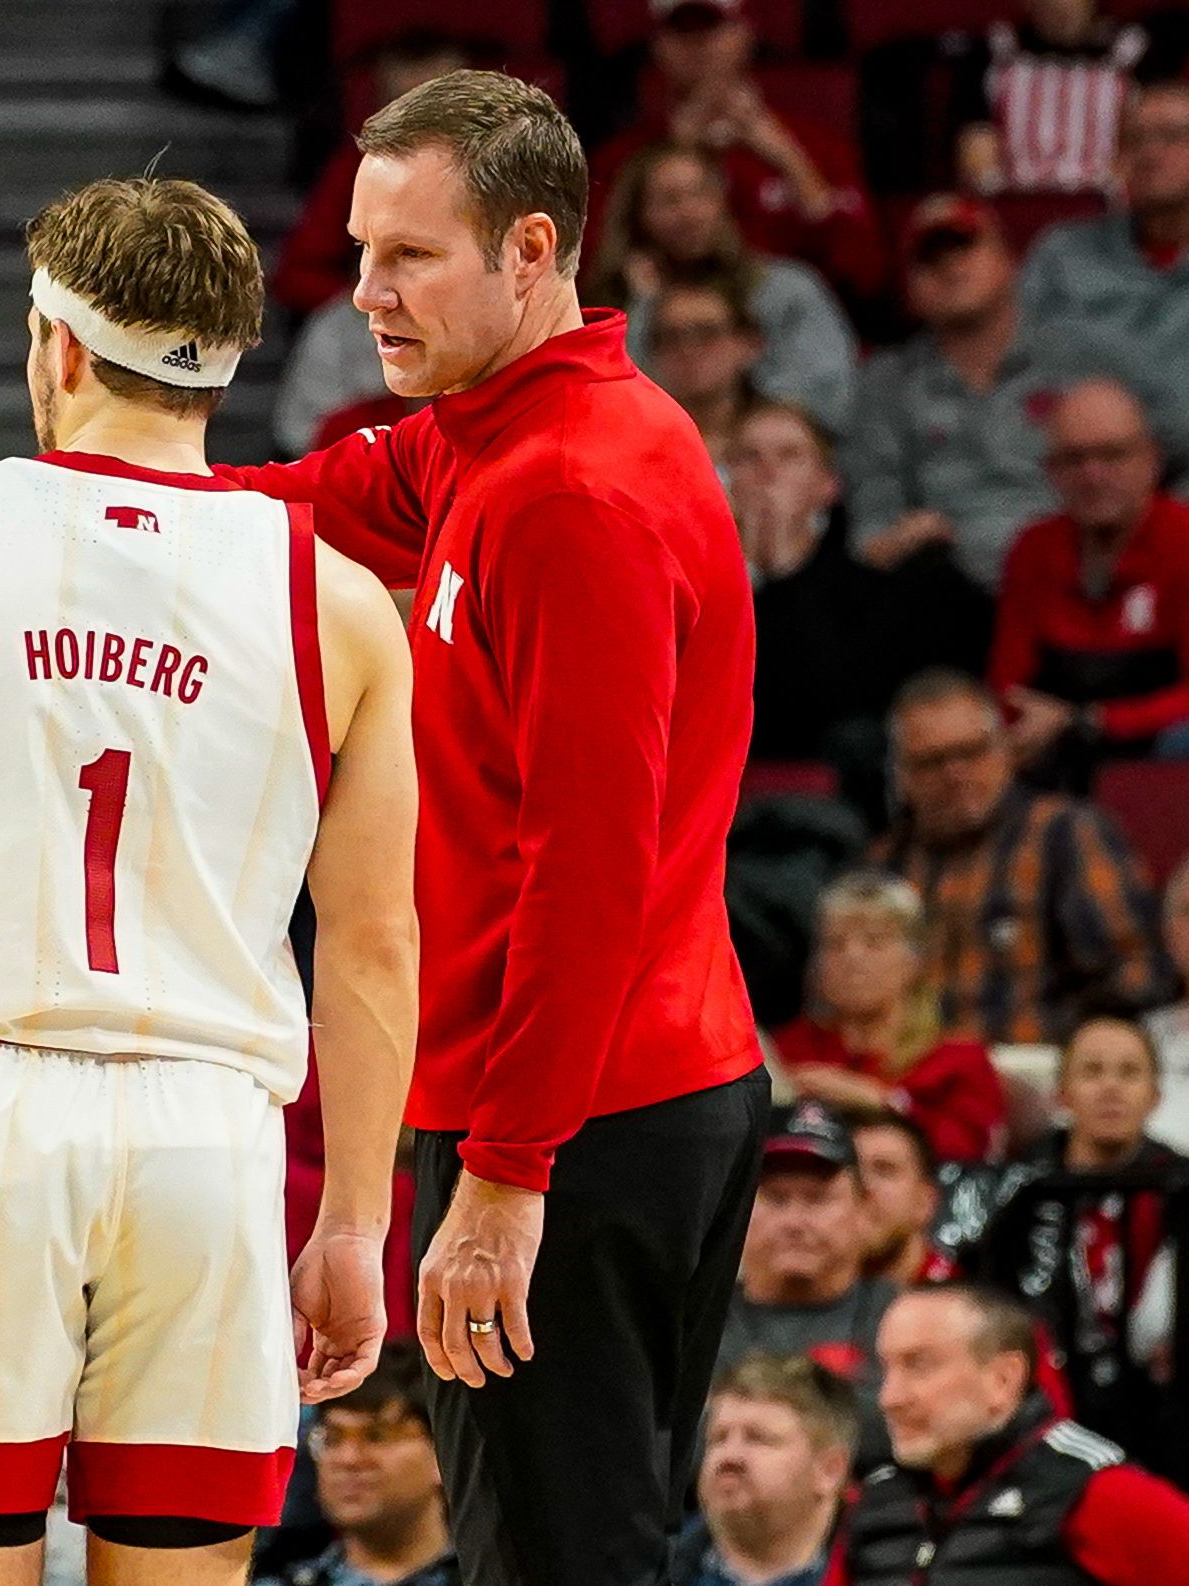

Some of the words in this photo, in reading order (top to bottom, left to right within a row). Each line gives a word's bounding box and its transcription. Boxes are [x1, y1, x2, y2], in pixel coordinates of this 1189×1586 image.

[162, 355, 201, 372] adidas
[137, 514, 156, 532] N
[426, 560, 464, 645] N
[24, 628, 208, 704] HOIBERG
[78, 748, 131, 974] 1
